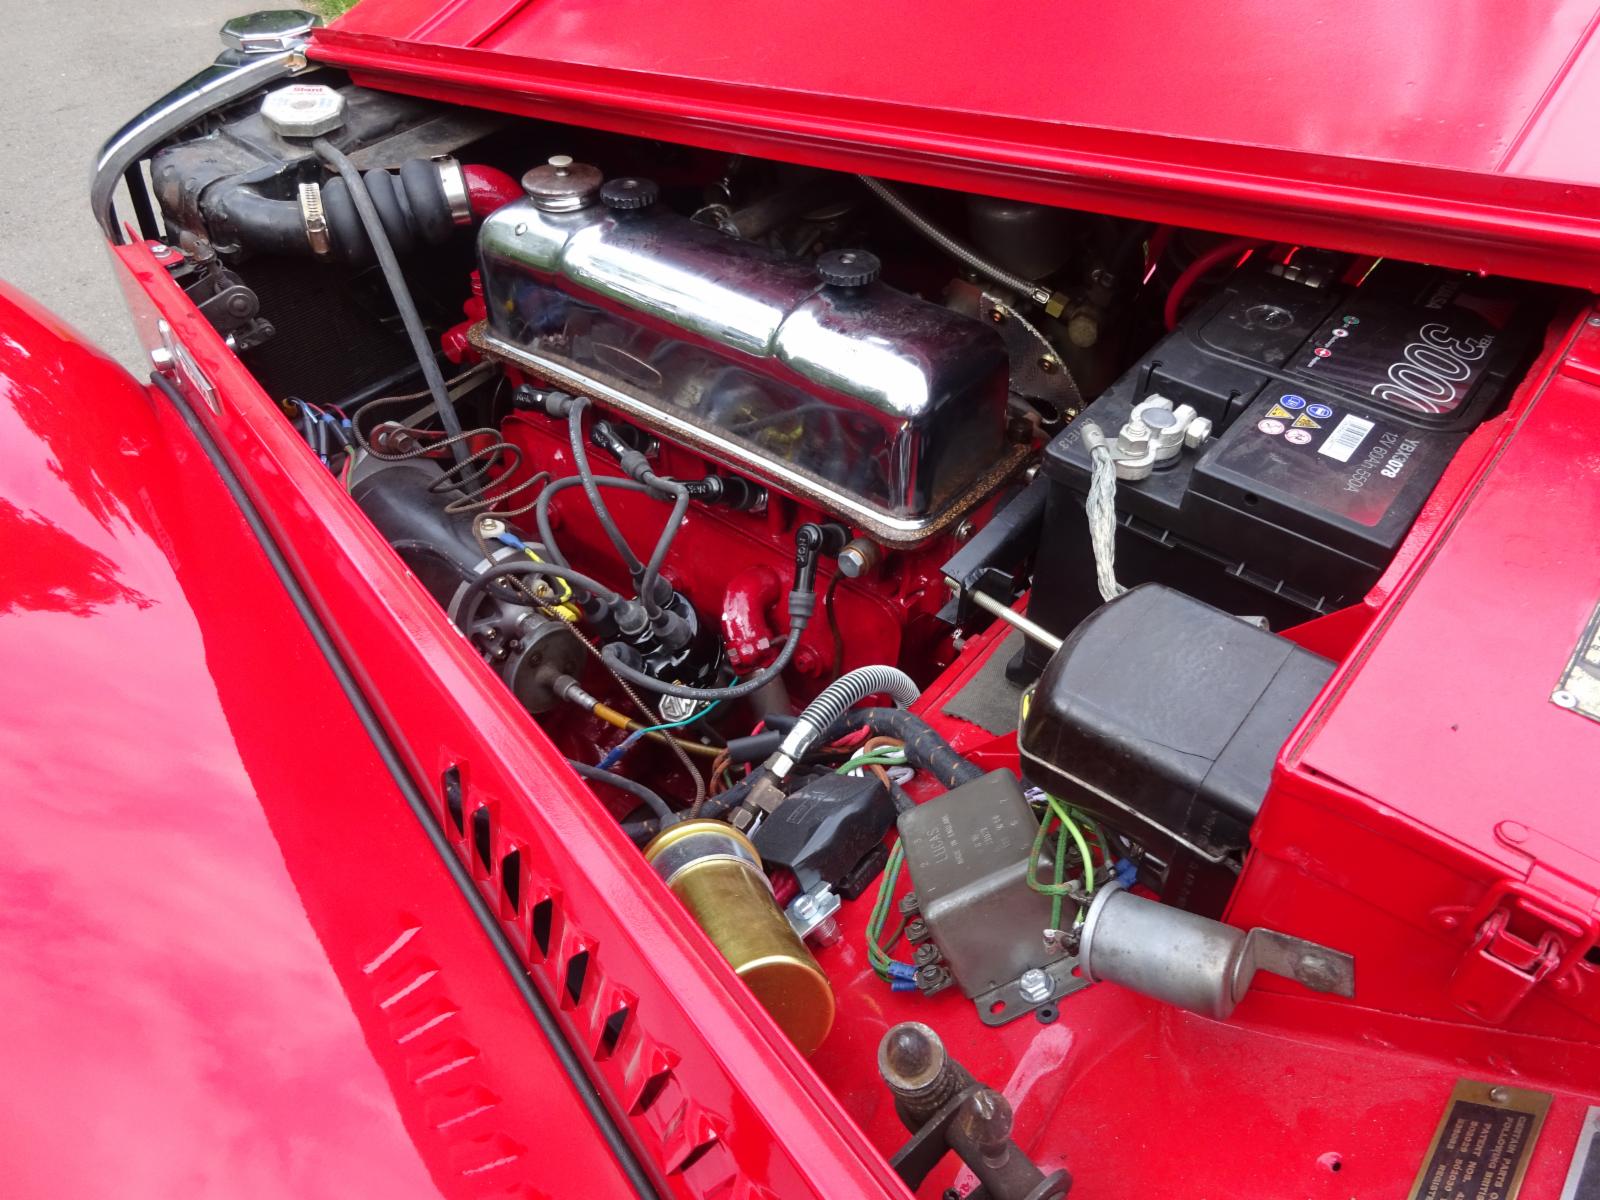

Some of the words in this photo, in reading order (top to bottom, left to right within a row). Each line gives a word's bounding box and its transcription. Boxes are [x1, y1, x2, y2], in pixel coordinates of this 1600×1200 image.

[1361, 446, 1389, 469] 60Ah
[1379, 432, 1399, 449] 12V
[1381, 437, 1420, 479] YBX3078
[1343, 467, 1372, 493] 550A
[926, 827, 949, 864] LUCAS
[1472, 1122, 1493, 1157] PATENT
[1487, 1116, 1514, 1170] FOLLOWING
[1507, 1115, 1527, 1156] CERTAIN
[1495, 1157, 1512, 1189] PARTS
